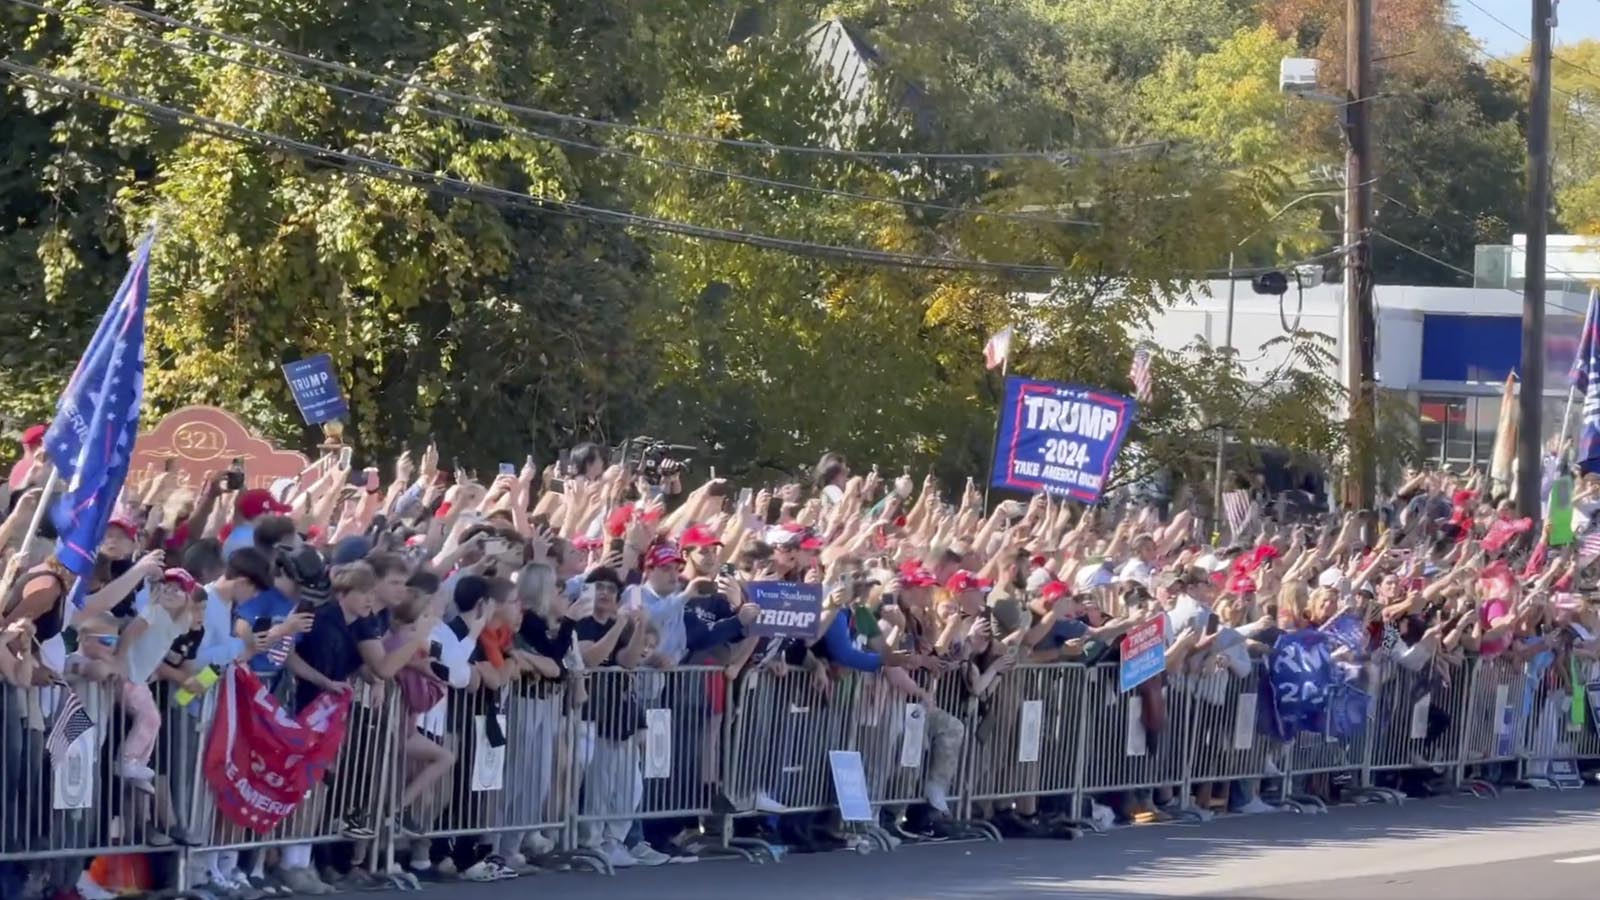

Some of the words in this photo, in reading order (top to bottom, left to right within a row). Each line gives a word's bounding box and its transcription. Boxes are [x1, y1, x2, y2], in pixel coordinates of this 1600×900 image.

[291, 371, 329, 392] TRUMP
[1024, 395, 1118, 441] TRUMP
[177, 430, 219, 450] 321
[1014, 460, 1040, 475] TAKE
[1041, 463, 1079, 484] AMERICA
[756, 588, 779, 599] Penn
[780, 590, 816, 602] Students
[756, 609, 816, 628] TRUMP
